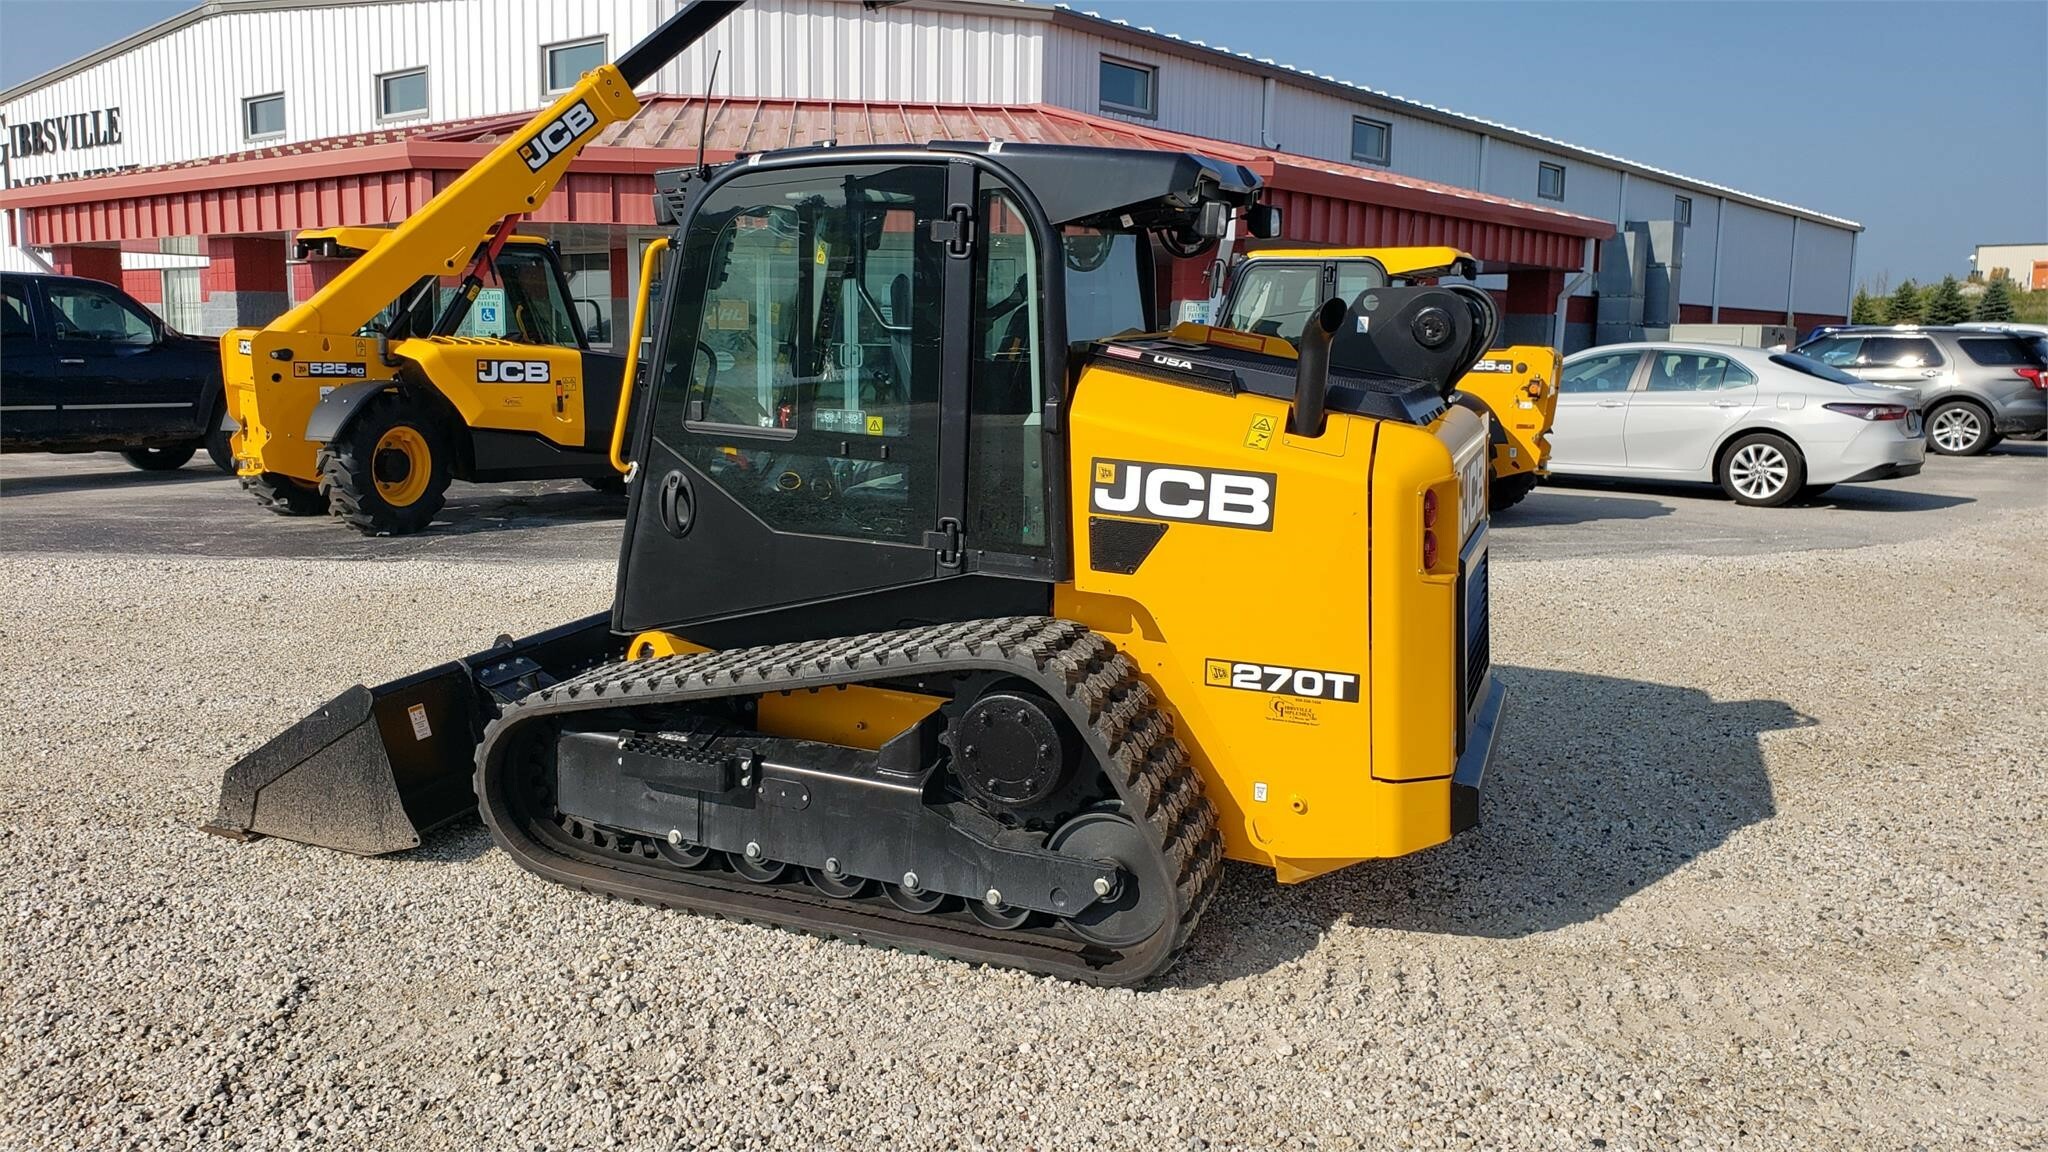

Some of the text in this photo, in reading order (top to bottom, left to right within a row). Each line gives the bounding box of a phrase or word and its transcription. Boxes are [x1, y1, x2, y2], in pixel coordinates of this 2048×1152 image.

[527, 103, 595, 169] JCB
[478, 361, 549, 382] JCB
[1153, 355, 1193, 370] USA
[1472, 360, 1512, 371] 25-60
[1094, 465, 1270, 526] JCB
[1463, 453, 1484, 535] JCB
[1232, 663, 1355, 700] 270T
